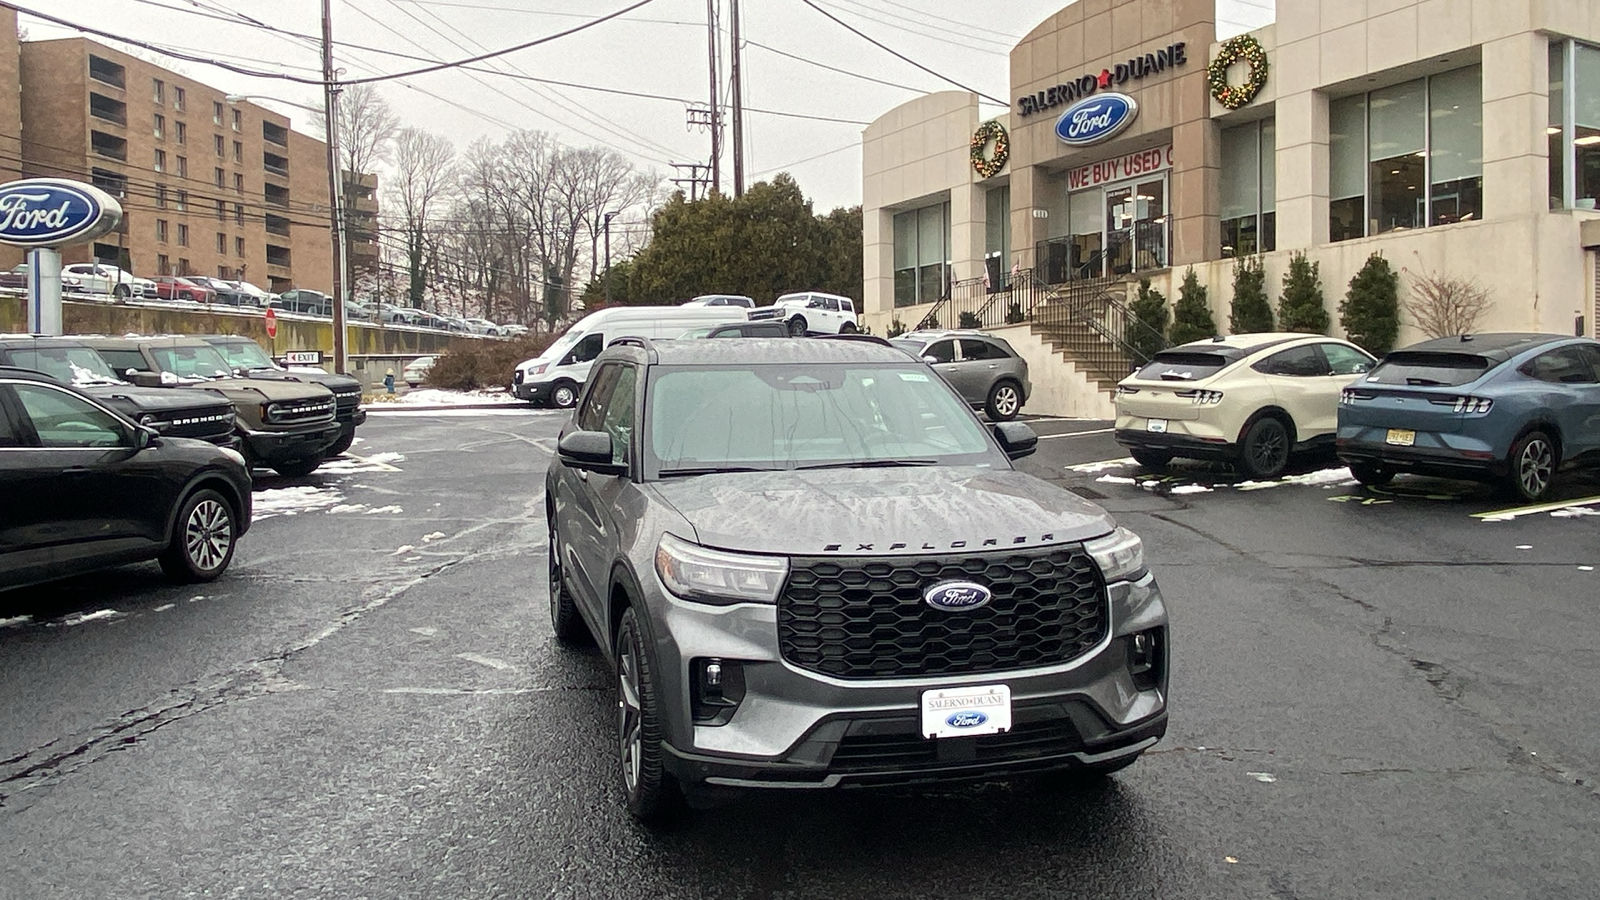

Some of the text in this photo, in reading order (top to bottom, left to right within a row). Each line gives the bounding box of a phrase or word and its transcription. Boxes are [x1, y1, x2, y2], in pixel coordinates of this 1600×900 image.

[1017, 41, 1187, 117] SALERNO DUANE
[1068, 103, 1112, 137] Ford
[1069, 166, 1089, 189] WE
[1093, 158, 1119, 184] BUY
[1124, 149, 1161, 176] USED
[0, 193, 71, 232] Ford
[298, 353, 315, 361] EXIT
[173, 415, 223, 425] BRONCO
[823, 533, 1054, 551] EXPLORER
[942, 588, 978, 604] Ford
[928, 694, 1004, 709] SALERNO DUANE
[953, 713, 980, 726] Ford
